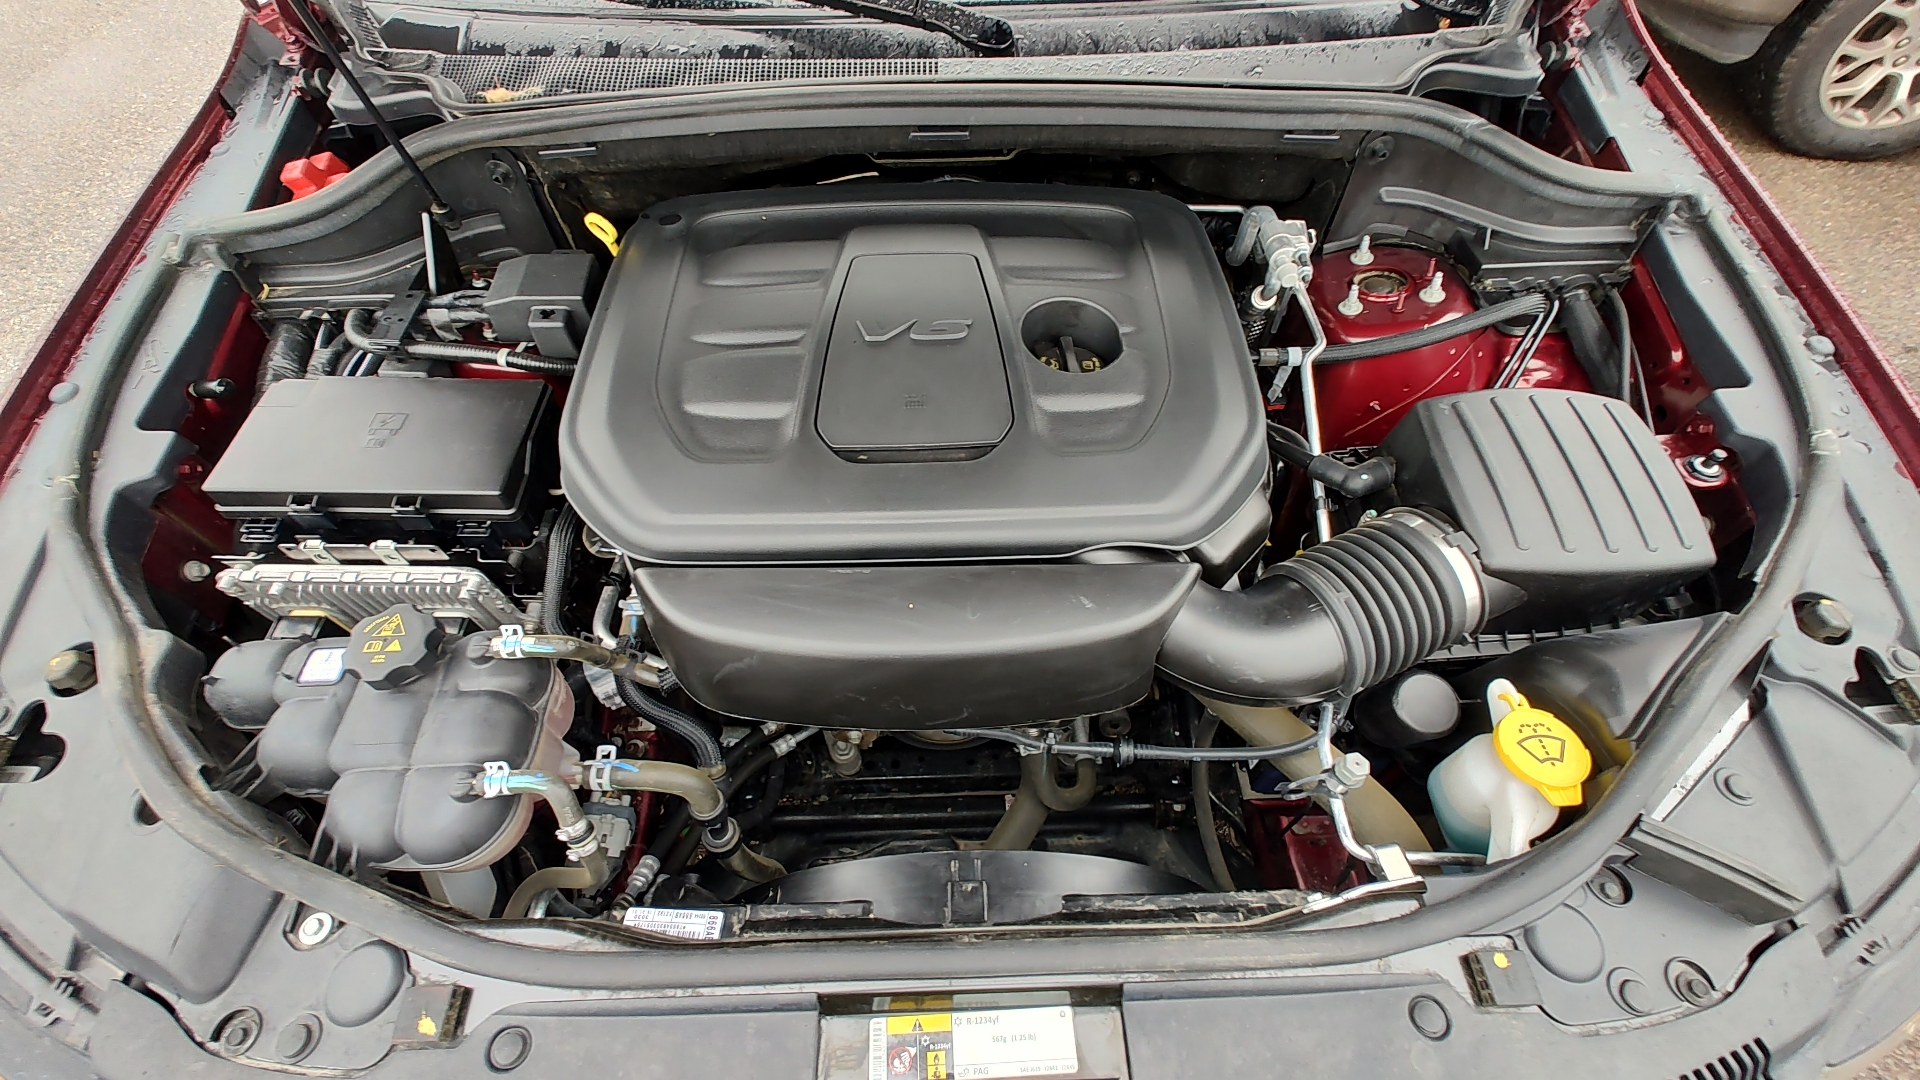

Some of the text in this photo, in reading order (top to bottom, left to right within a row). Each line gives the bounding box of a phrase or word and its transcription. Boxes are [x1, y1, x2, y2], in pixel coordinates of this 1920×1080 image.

[855, 318, 974, 342] V6
[967, 1016, 1000, 1026] R-1234yf
[992, 1036, 1007, 1044] 567g
[1011, 1034, 1027, 1042] (1.25
[973, 1067, 989, 1075] PAG
